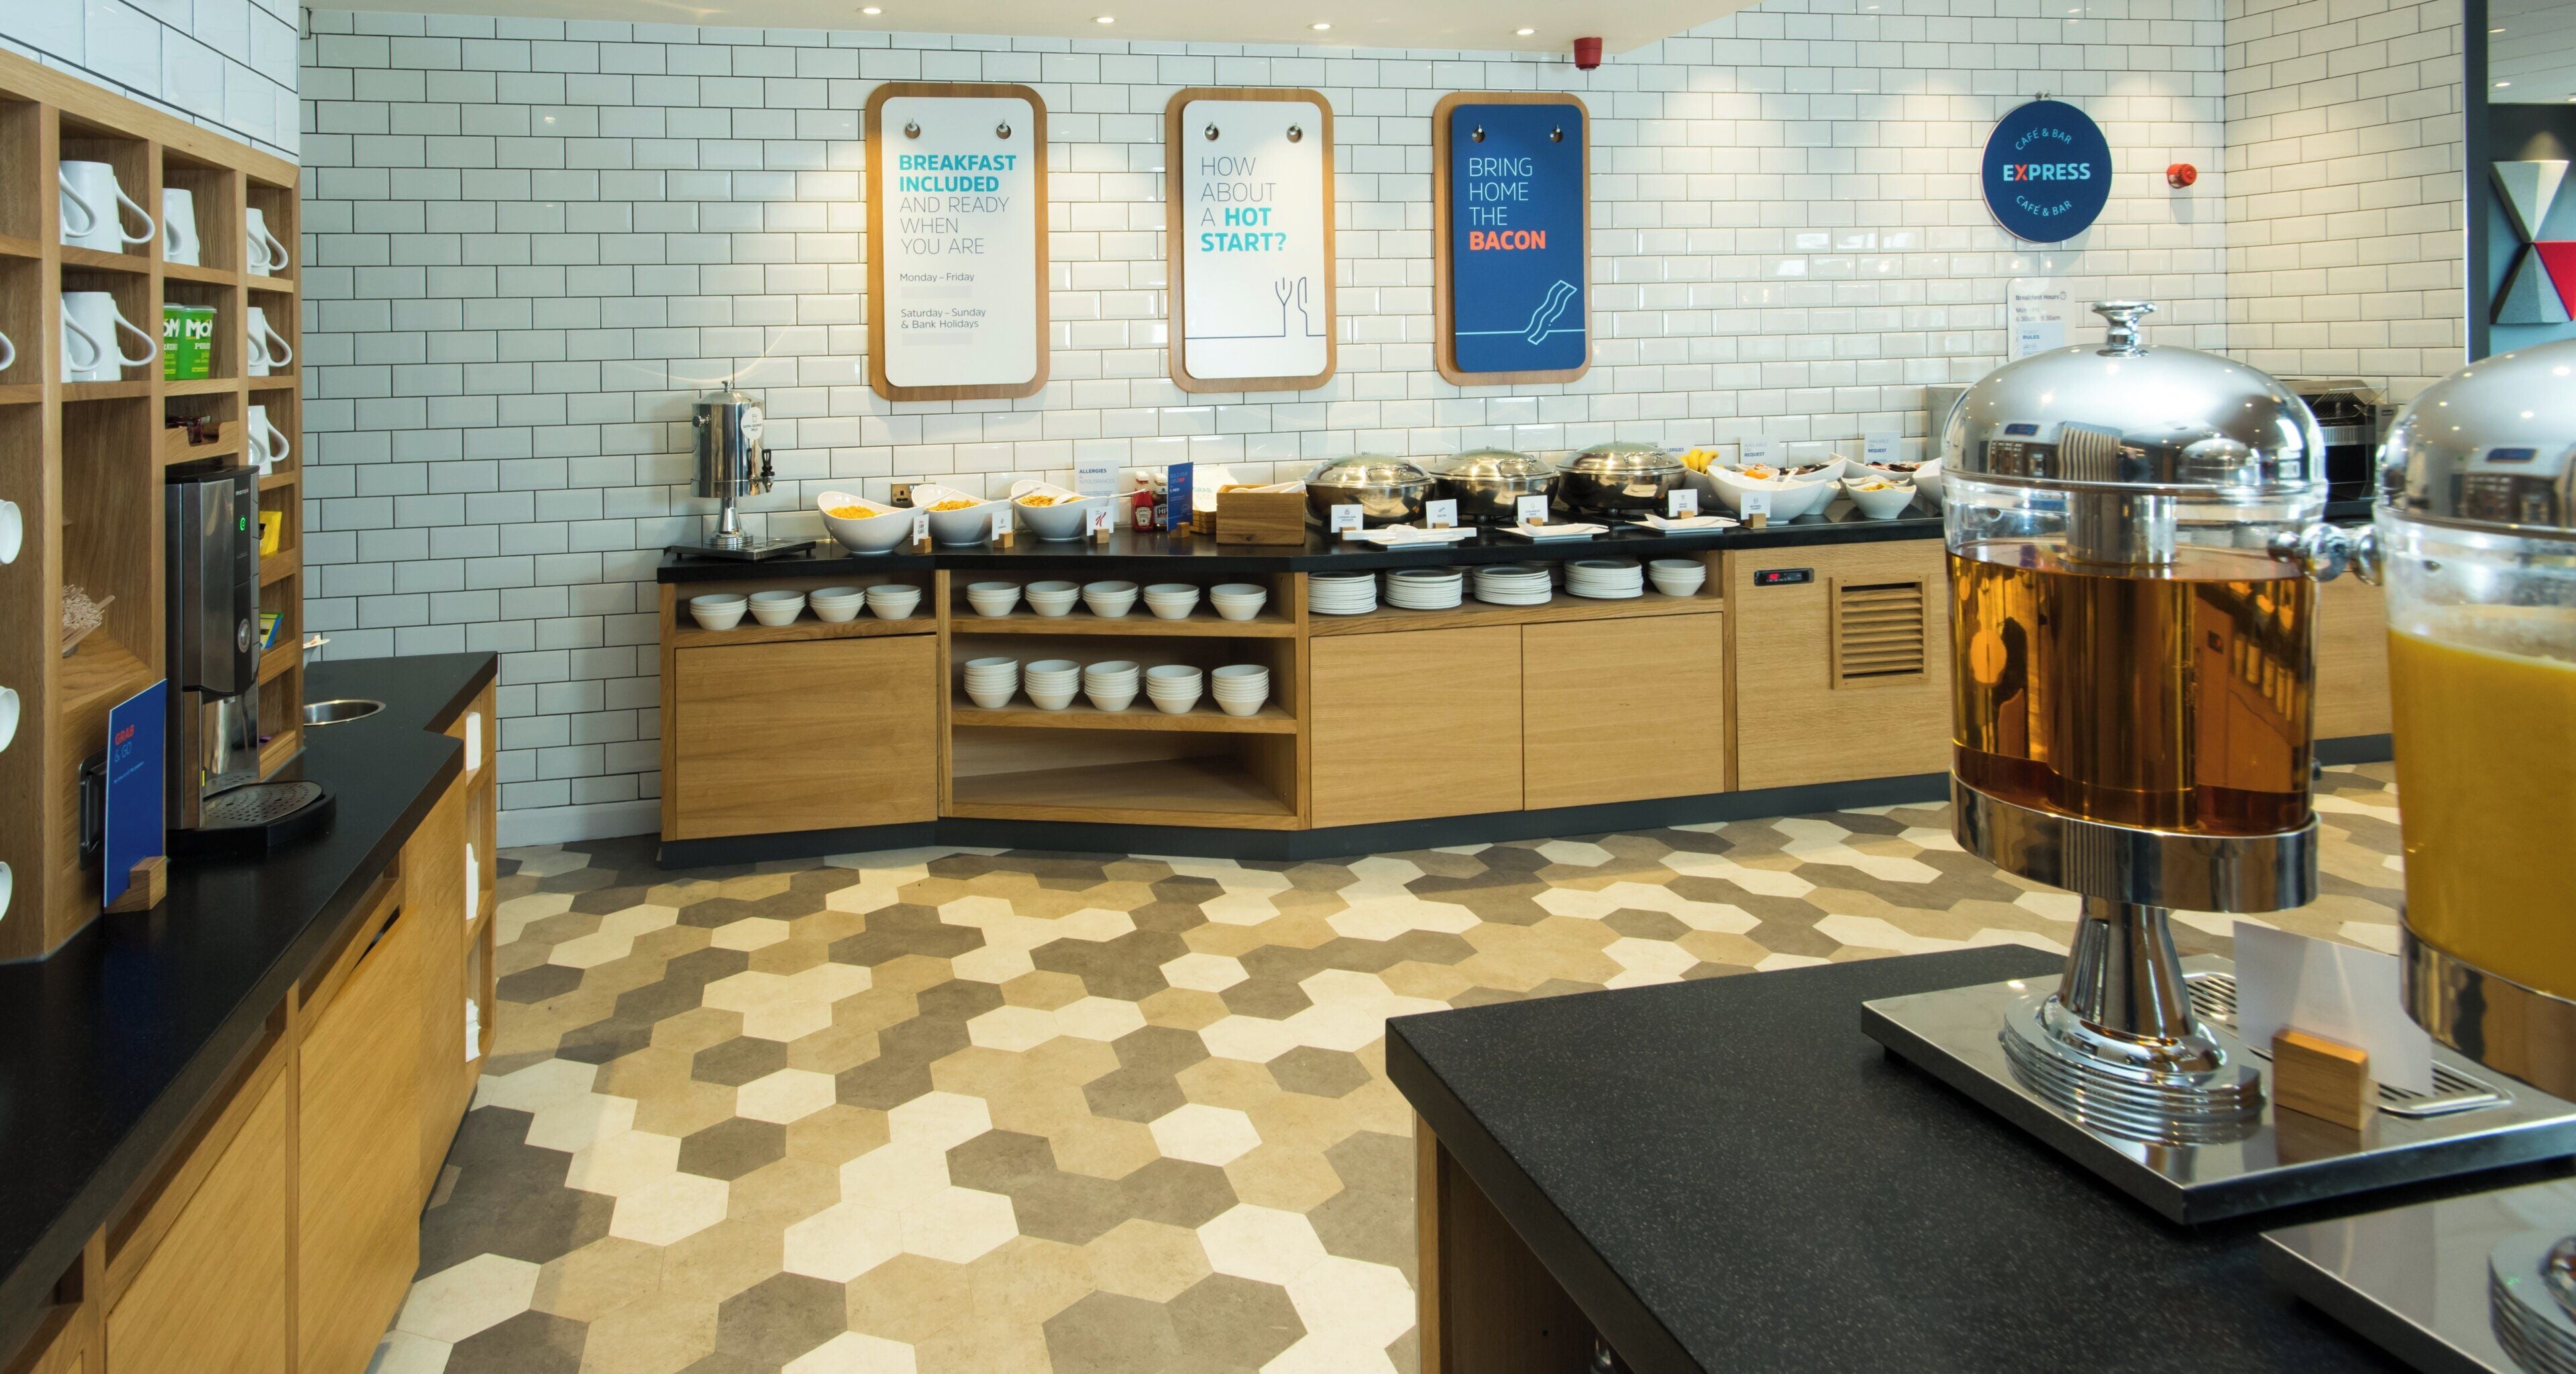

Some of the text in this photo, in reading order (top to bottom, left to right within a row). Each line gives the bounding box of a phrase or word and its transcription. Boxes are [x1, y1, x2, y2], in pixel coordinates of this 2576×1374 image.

[2015, 127, 2072, 150] CAFÉ & BAR
[899, 154, 1017, 171] BREAKFAST
[1201, 156, 1256, 176] HOW
[1469, 157, 1533, 177] BRING
[2002, 163, 2091, 181] EXPRESS
[900, 176, 1000, 192] INCLUDED
[1201, 182, 1277, 202] ABOUT
[1470, 182, 1529, 201] HOME
[900, 196, 1010, 213] AND READY
[2016, 195, 2073, 217] CAFÉ & BAR
[900, 217, 959, 233] WHEN
[1201, 207, 1272, 227] A HOT
[1468, 206, 1508, 226] THE
[901, 237, 985, 255] YOU ARE
[1201, 232, 1287, 252] START?
[1469, 230, 1546, 250] BACON
[900, 273, 938, 282] Monday
[946, 272, 975, 282] Friday
[901, 309, 943, 318] Saturday
[951, 308, 986, 317] Sunday
[164, 318, 180, 337] OM
[901, 319, 979, 329] & Bank Holidays
[115, 724, 135, 747] GRAB
